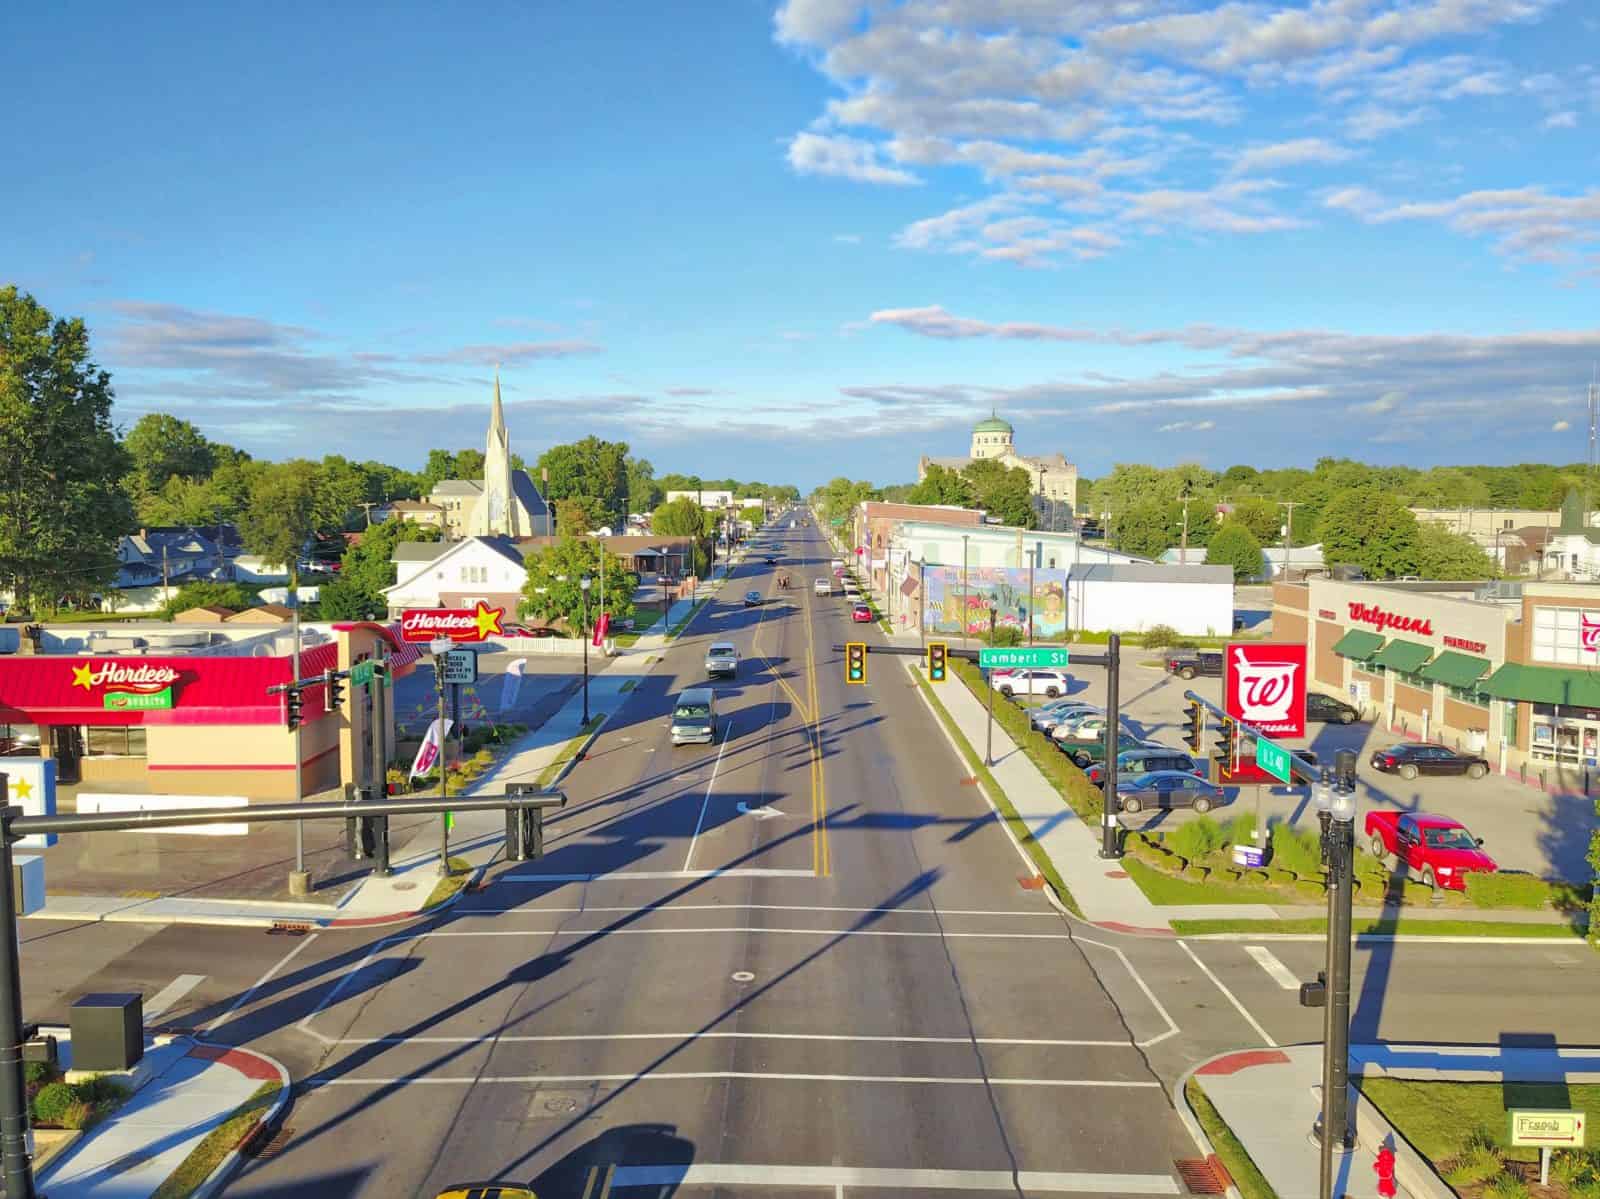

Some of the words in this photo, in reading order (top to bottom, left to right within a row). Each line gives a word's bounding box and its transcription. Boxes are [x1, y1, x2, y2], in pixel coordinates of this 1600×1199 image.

[404, 613, 478, 630] Hardee's
[1348, 602, 1433, 636] Walgreens
[983, 652, 1038, 664] Lambert
[1051, 653, 1064, 664] St
[90, 661, 179, 685] Hardee's
